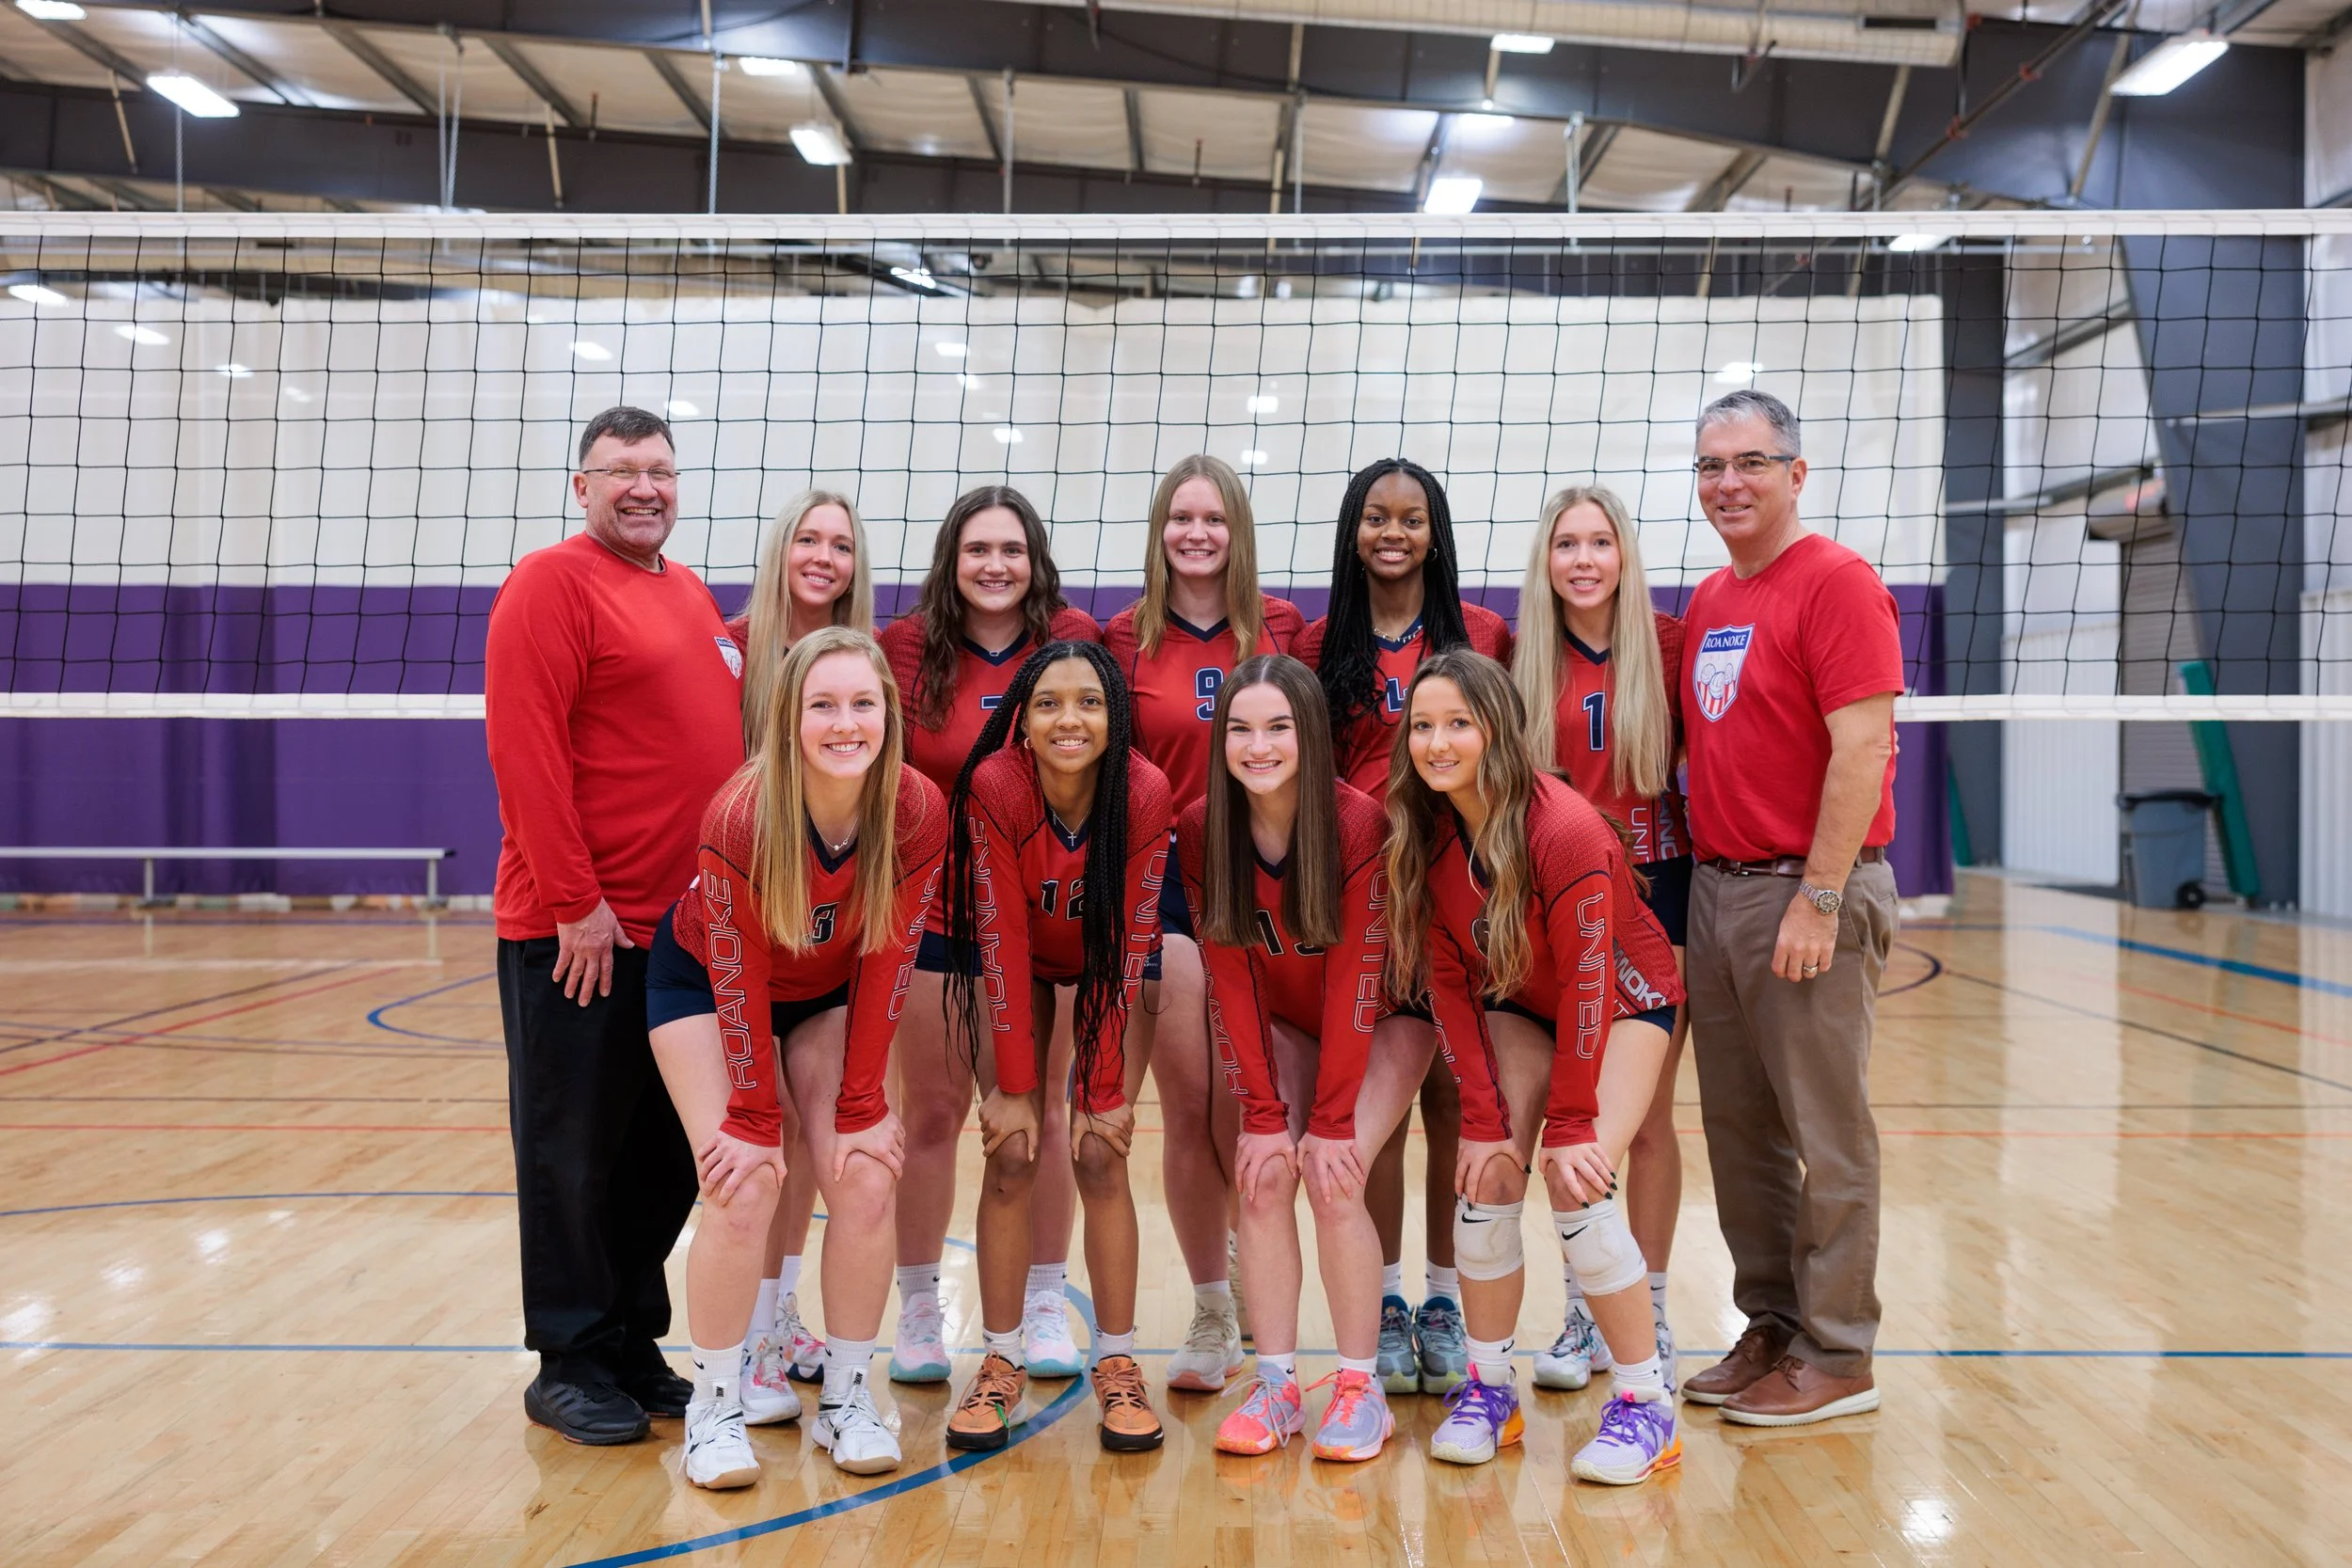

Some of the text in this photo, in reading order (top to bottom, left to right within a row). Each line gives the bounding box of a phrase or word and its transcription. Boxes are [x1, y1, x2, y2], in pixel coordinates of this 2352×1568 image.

[1705, 634, 1747, 649] ROANOKE
[1195, 667, 1224, 721] 9
[1582, 691, 1606, 751] 1
[808, 901, 839, 944] 3
[703, 868, 757, 1089] ROANOKE
[1576, 892, 1606, 1060] UNITED
